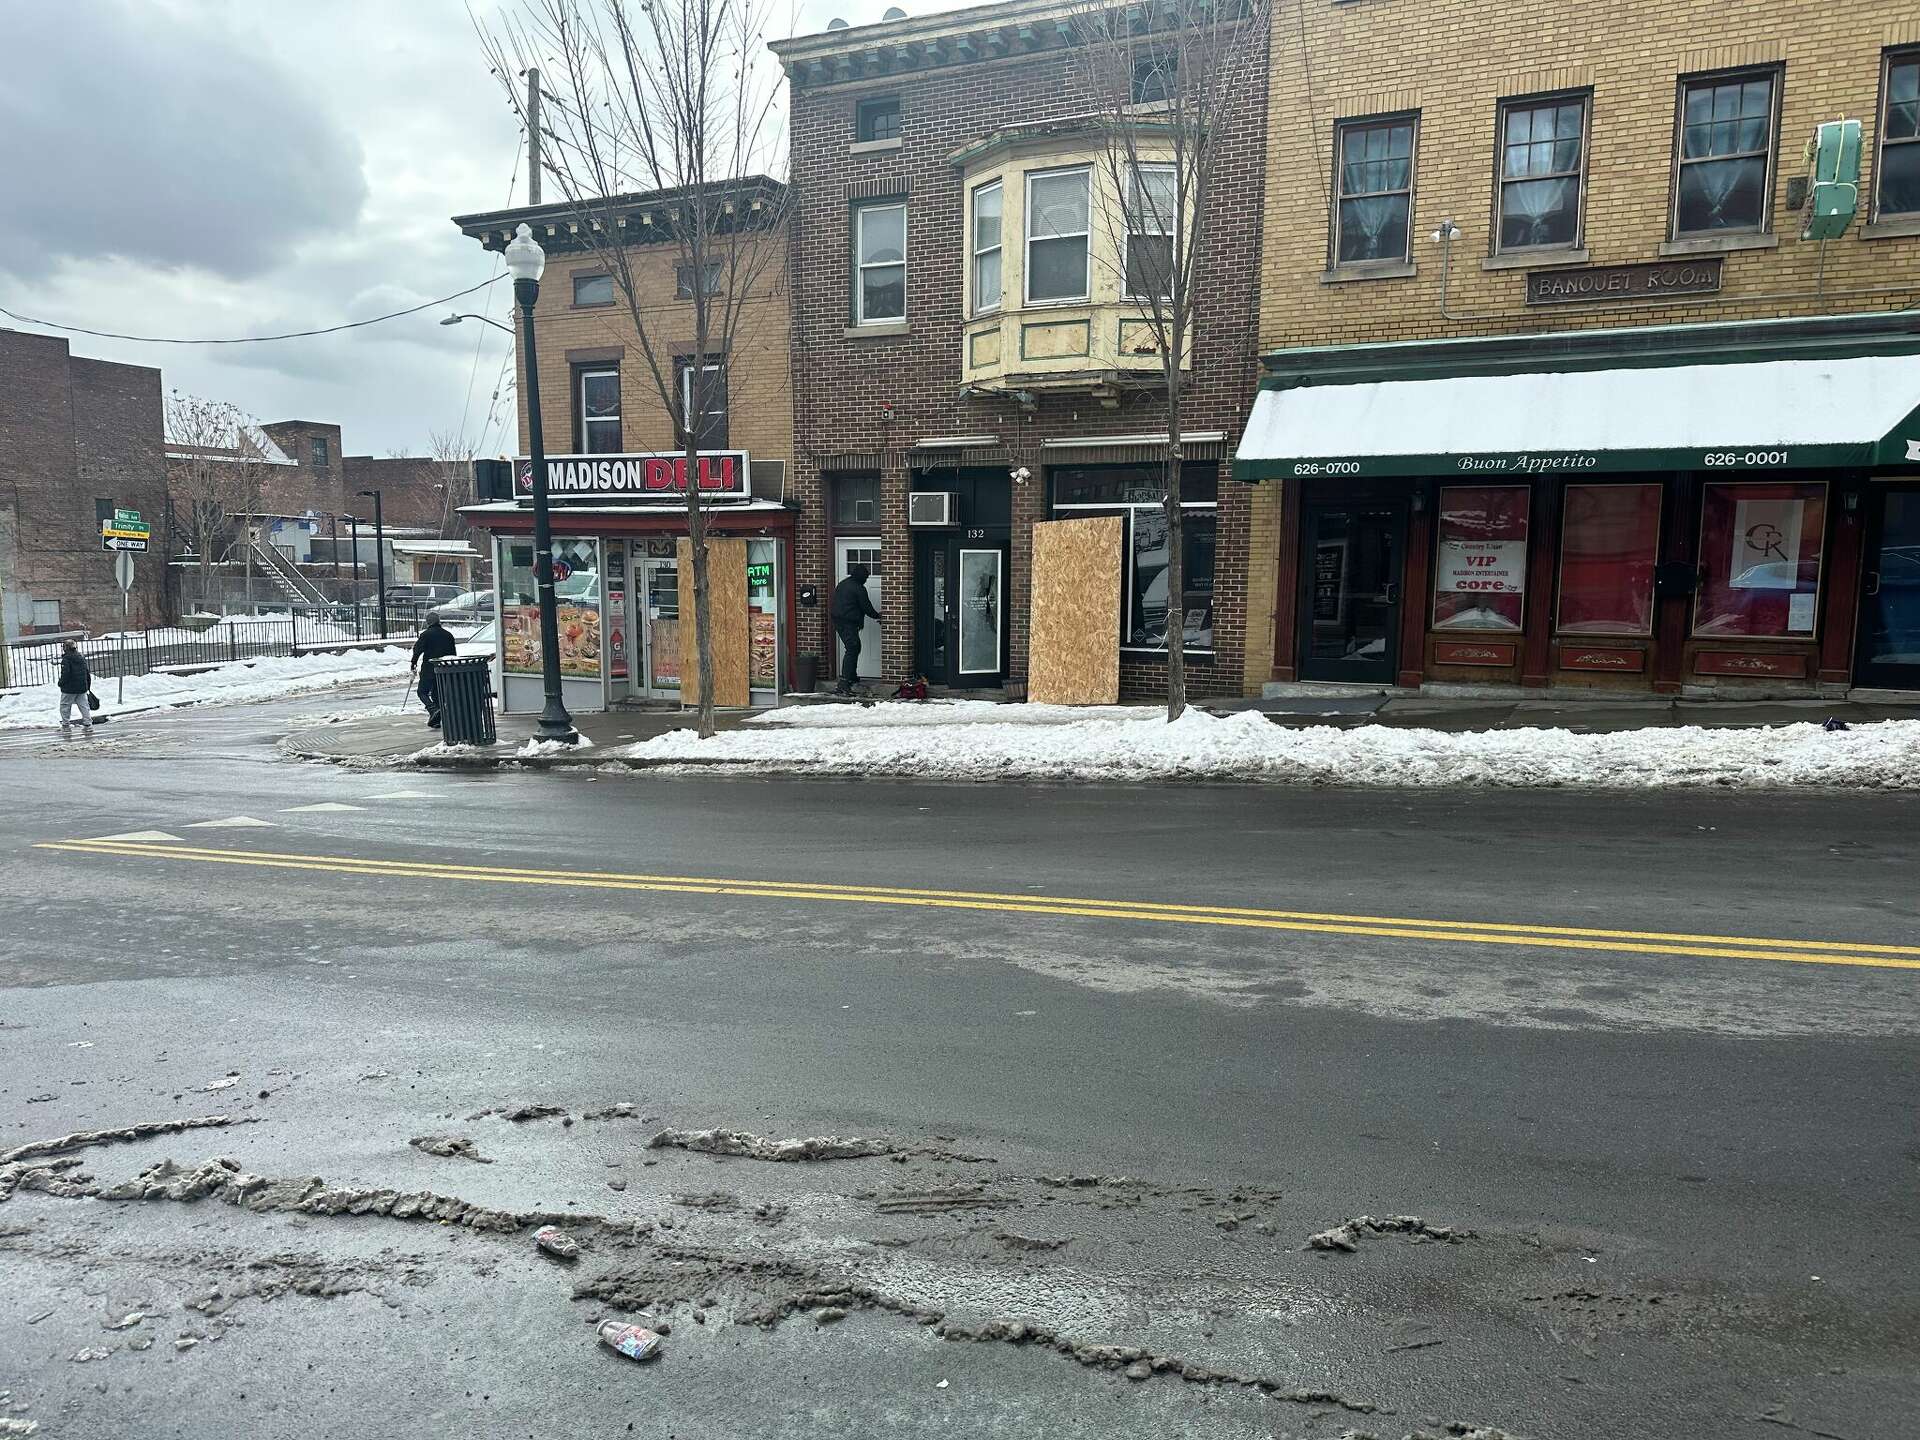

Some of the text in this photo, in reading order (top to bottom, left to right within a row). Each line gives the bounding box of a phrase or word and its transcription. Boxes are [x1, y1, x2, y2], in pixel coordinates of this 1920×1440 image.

[1457, 454, 1596, 473] Buon Appetito
[1704, 451, 1788, 466] 626-0001
[548, 457, 734, 490] MADISON DELI
[1294, 462, 1360, 475] 626-0700
[114, 522, 134, 530] Trinity
[967, 529, 985, 538] 132
[1466, 556, 1497, 567] VIP
[747, 565, 770, 577] ATM
[751, 578, 767, 586] here
[1455, 580, 1505, 591] core
